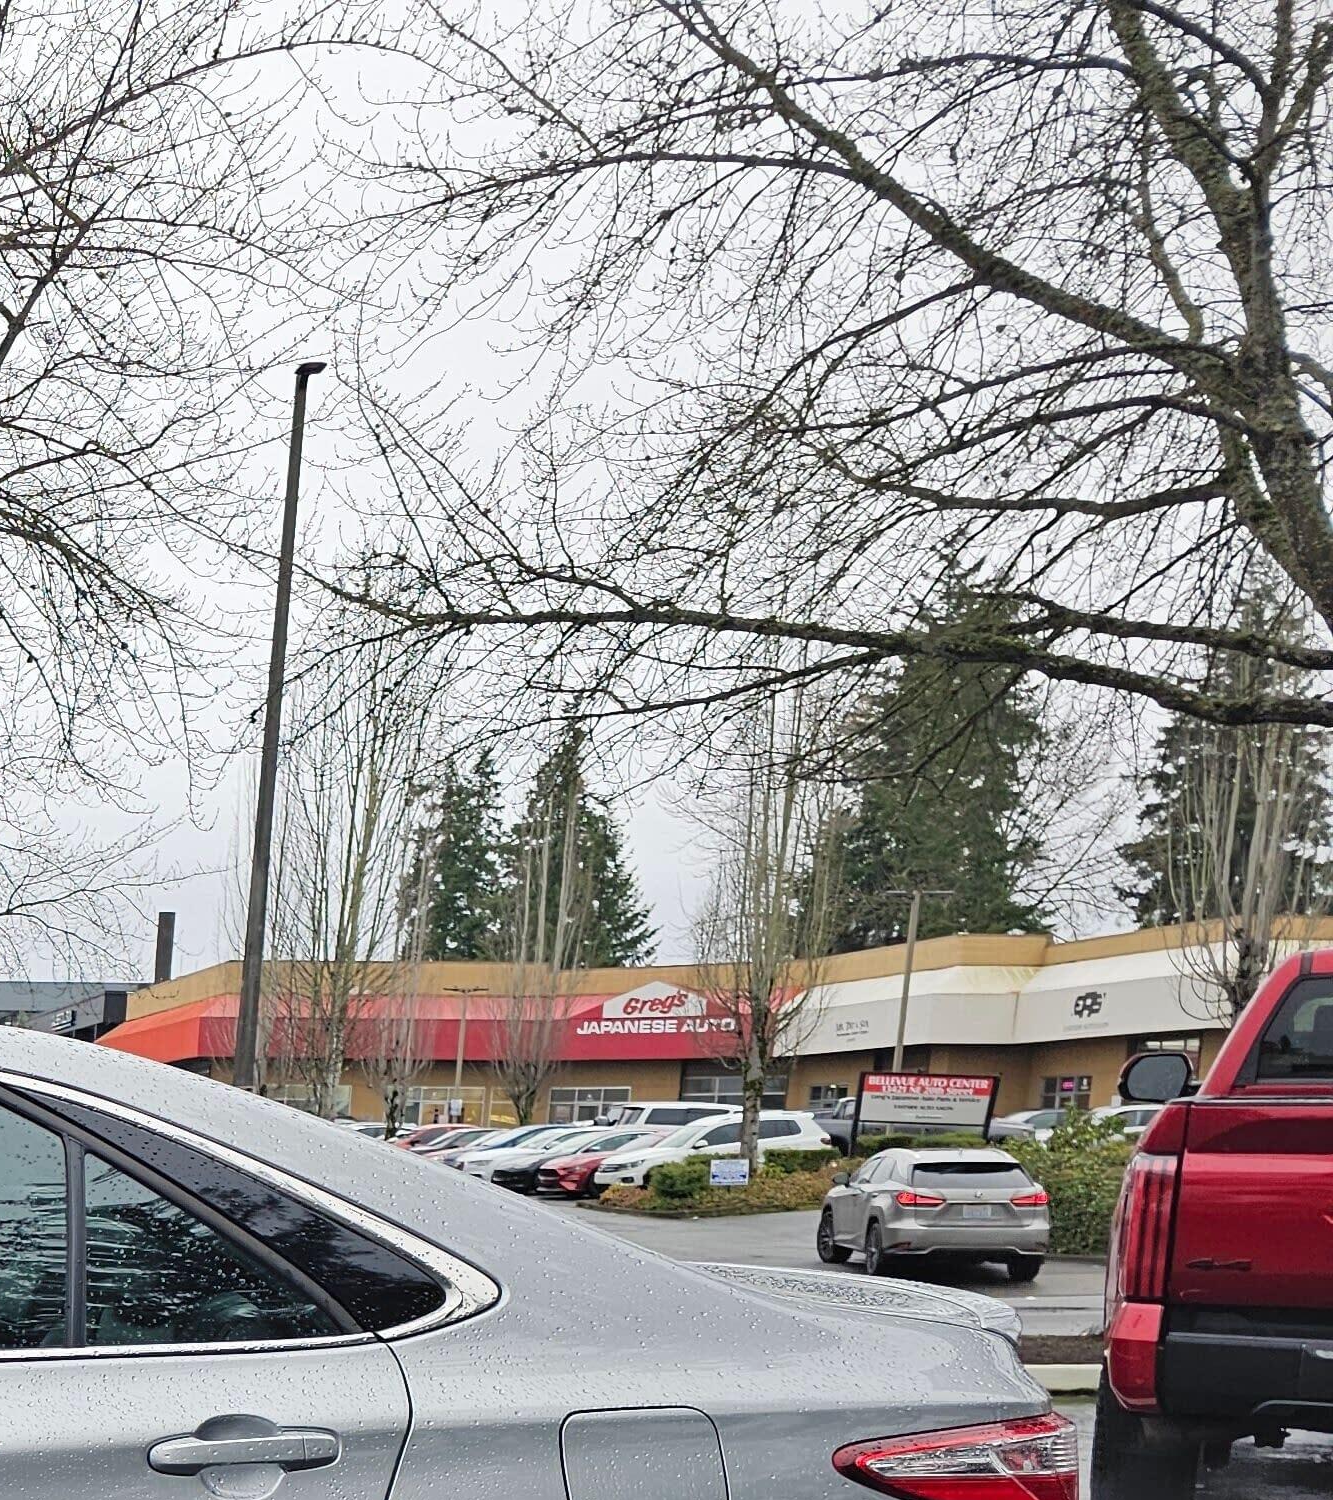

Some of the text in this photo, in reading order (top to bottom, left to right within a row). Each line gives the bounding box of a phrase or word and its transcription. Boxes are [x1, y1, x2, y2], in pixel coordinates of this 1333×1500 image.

[622, 990, 688, 1015] Greg's
[576, 1018, 735, 1035] JAPANESE AUTO
[868, 1075, 989, 1089] BELLEVUE AUTO CENTER
